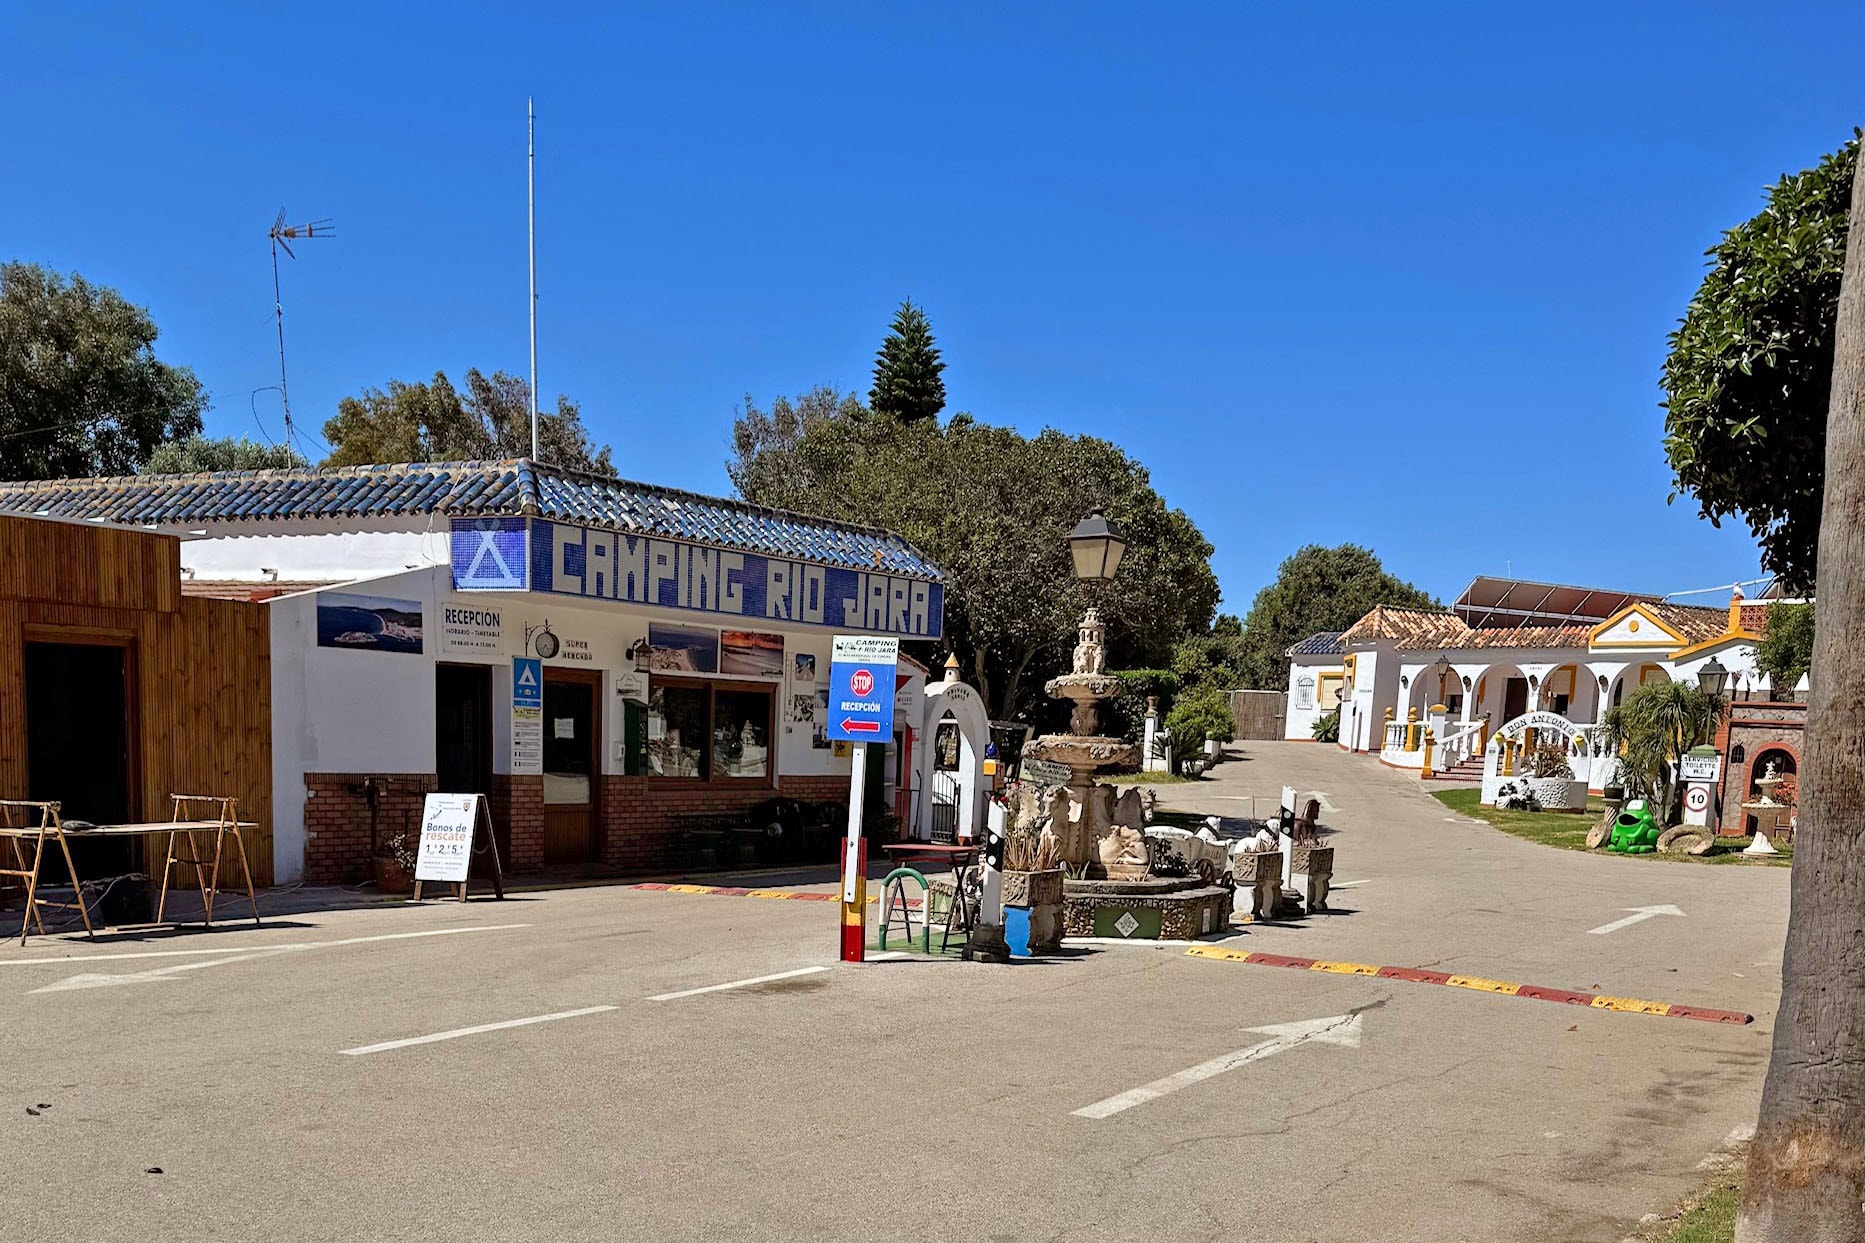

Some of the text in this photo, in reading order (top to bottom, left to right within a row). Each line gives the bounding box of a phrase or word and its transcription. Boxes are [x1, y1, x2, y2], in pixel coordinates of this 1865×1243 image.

[552, 523, 930, 635] CAMPING RIO JARA
[445, 608, 500, 627] RECEPCIÓN
[446, 628, 470, 636] HORARIO
[566, 640, 588, 649] SUPER
[856, 639, 897, 647] CAMPING
[562, 651, 593, 661] MERCADO
[853, 675, 871, 690] STOP
[841, 701, 881, 713] RECEPCIÓN
[1507, 715, 1577, 736] DON ANTONIO
[1691, 794, 1705, 804] 10
[426, 822, 467, 833] Bonos de
[426, 832, 466, 841] rescate
